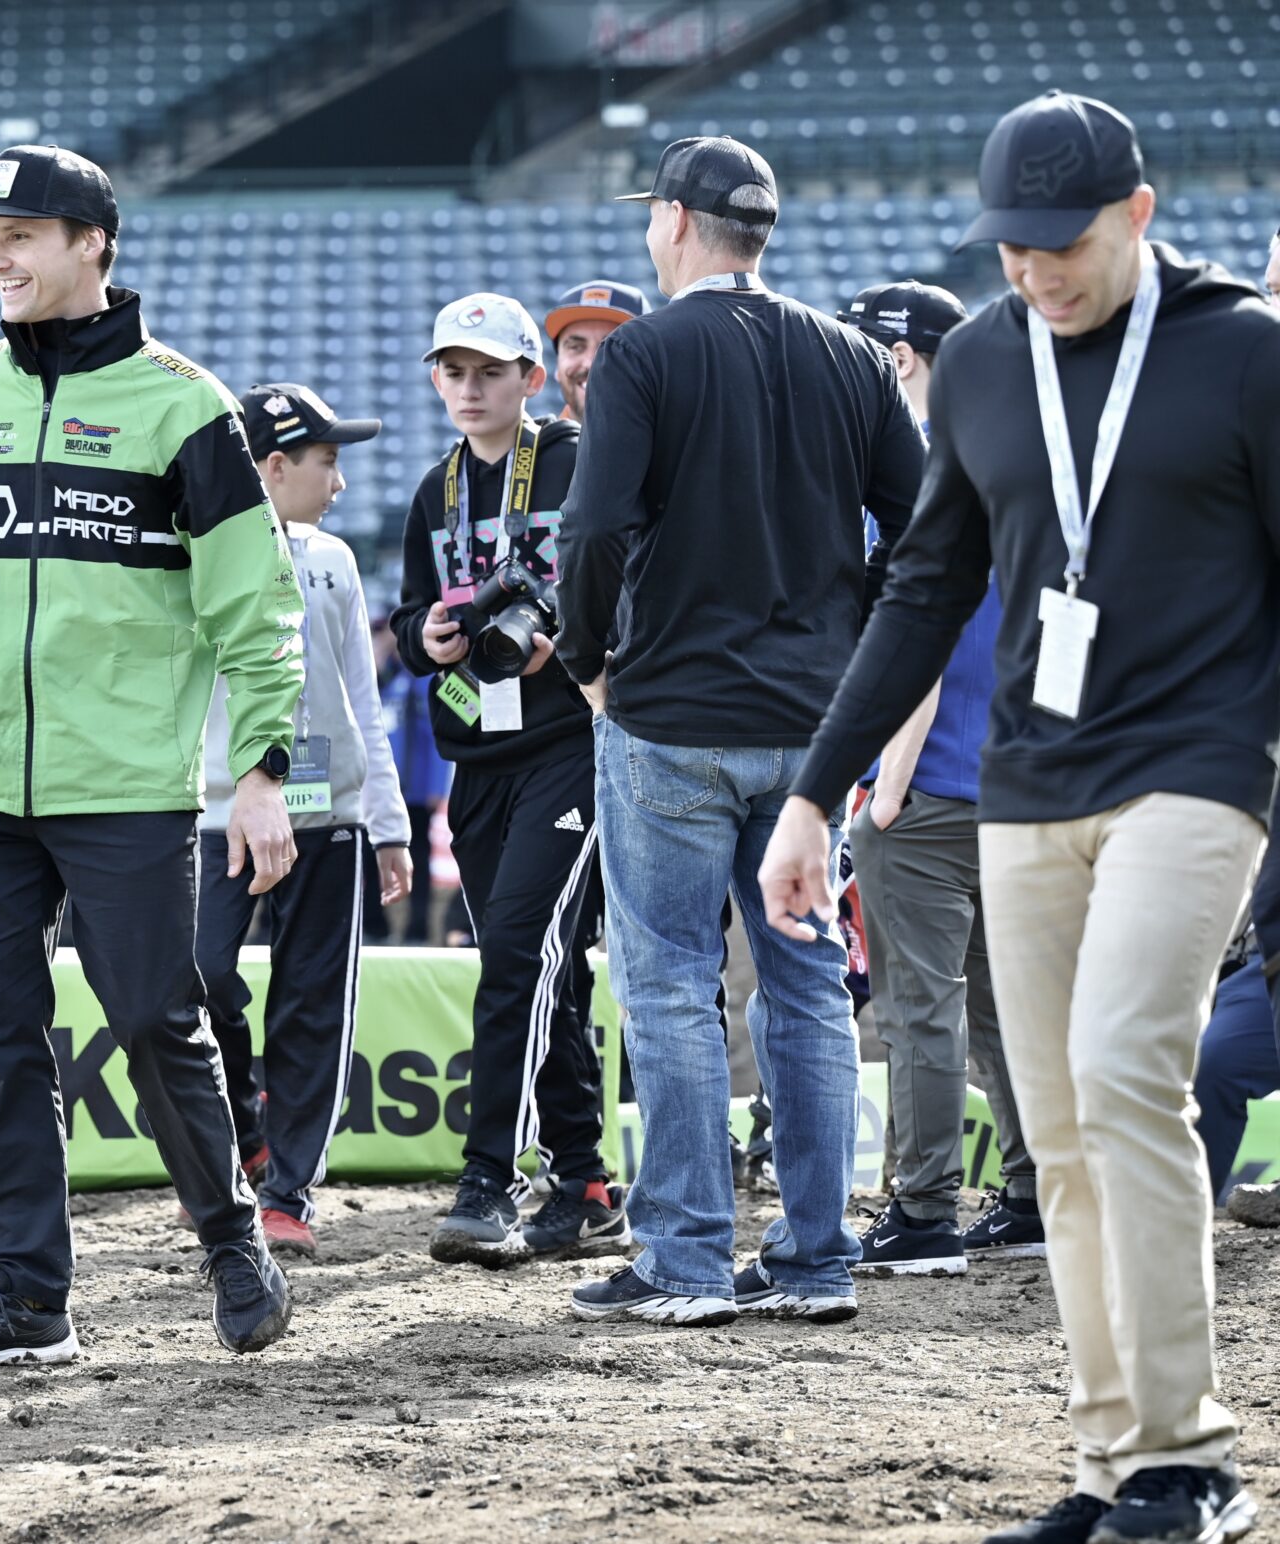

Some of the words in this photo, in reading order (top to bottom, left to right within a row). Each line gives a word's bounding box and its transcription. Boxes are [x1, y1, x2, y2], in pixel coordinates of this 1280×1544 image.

[64, 421, 81, 434] BIG
[83, 441, 112, 454] RACING
[54, 485, 136, 517] MADD
[514, 483, 525, 510] Nikon
[52, 516, 133, 545] PARTS
[444, 682, 468, 706] VIP
[285, 793, 313, 806] VIP
[554, 820, 585, 832] adidas
